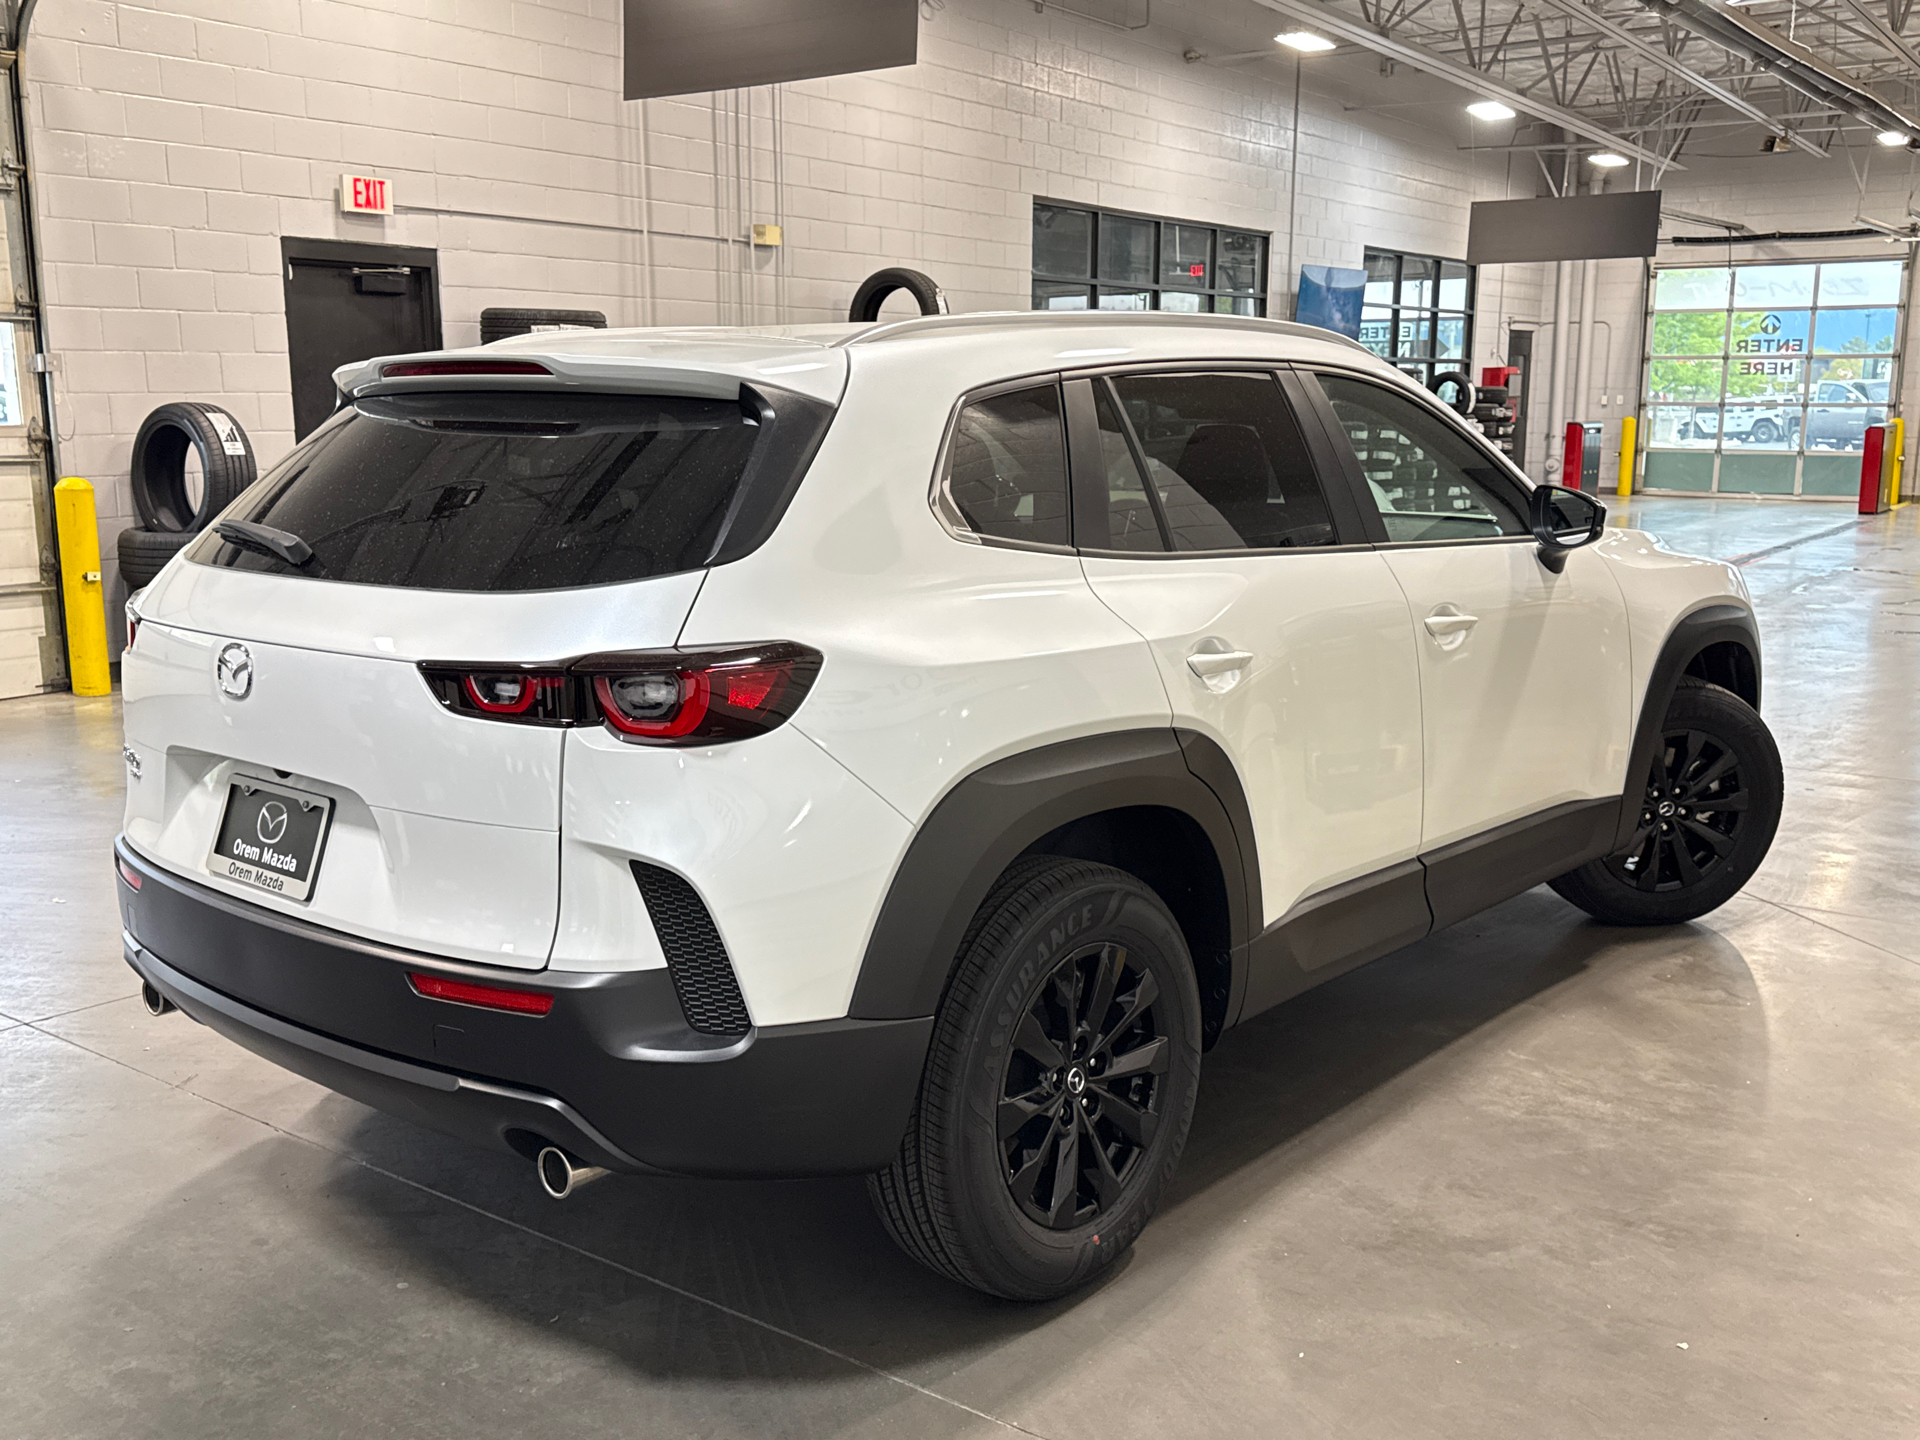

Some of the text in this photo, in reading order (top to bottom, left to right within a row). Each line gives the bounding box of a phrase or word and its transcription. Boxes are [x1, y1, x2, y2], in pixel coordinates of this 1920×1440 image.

[353, 177, 385, 210] EXIT
[233, 838, 297, 872] Orem Mazda
[228, 861, 284, 891] Orem Mazda
[984, 903, 1093, 1081] ASSURANCE
